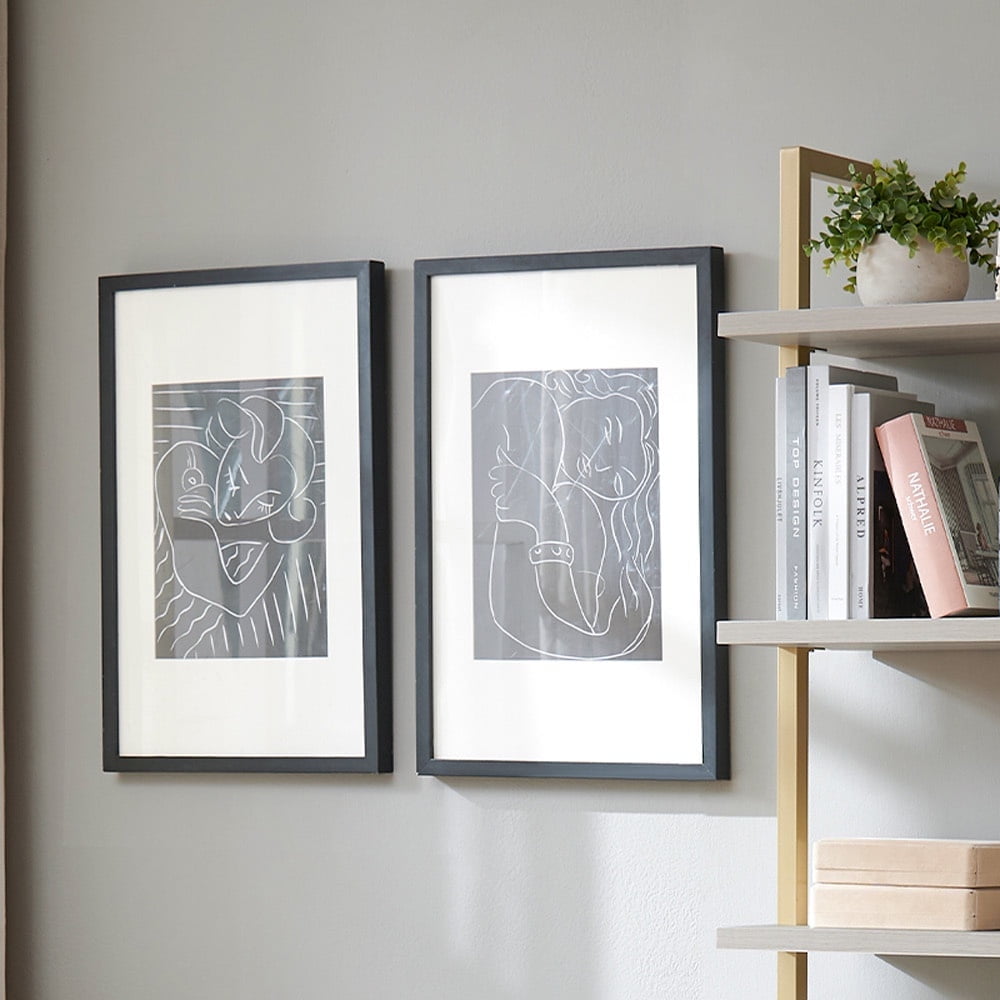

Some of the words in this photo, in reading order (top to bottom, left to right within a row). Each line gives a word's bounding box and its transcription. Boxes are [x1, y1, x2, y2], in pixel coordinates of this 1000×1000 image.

[792, 436, 800, 469] TOP
[792, 477, 800, 538] DESIGN
[812, 459, 824, 528] KINFOLK
[907, 471, 936, 536] NATHALIE
